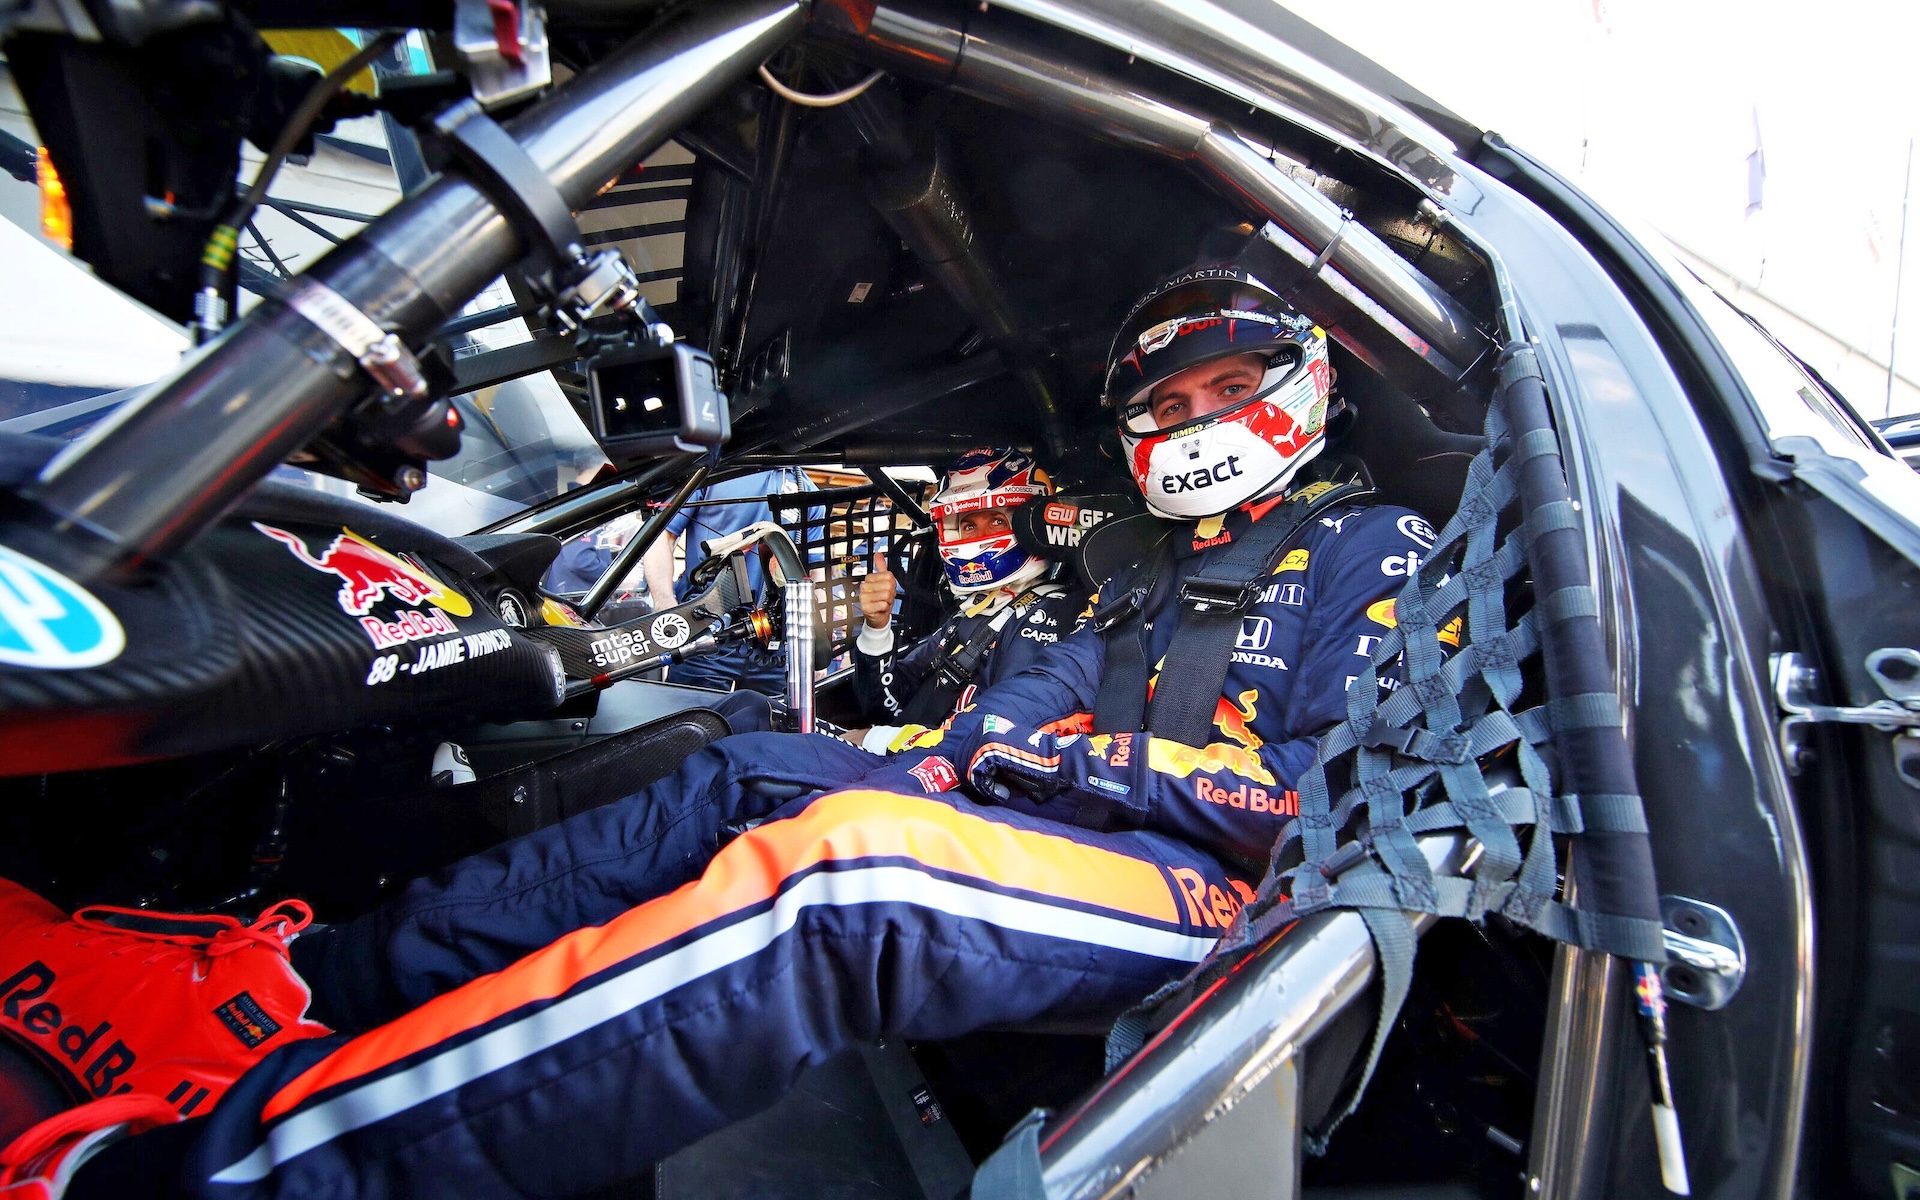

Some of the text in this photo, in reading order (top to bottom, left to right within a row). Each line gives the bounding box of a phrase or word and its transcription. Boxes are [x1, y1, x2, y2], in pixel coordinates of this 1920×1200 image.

[1164, 269, 1238, 289] MARTIN
[1161, 454, 1244, 494] exact
[952, 501, 980, 512] vodafone
[589, 629, 646, 655] mtaa
[593, 640, 652, 667] super
[366, 653, 400, 686] 88
[410, 637, 465, 675] JAMIE
[463, 628, 514, 659] WHINCUP
[83, 1039, 211, 1117] Bll
